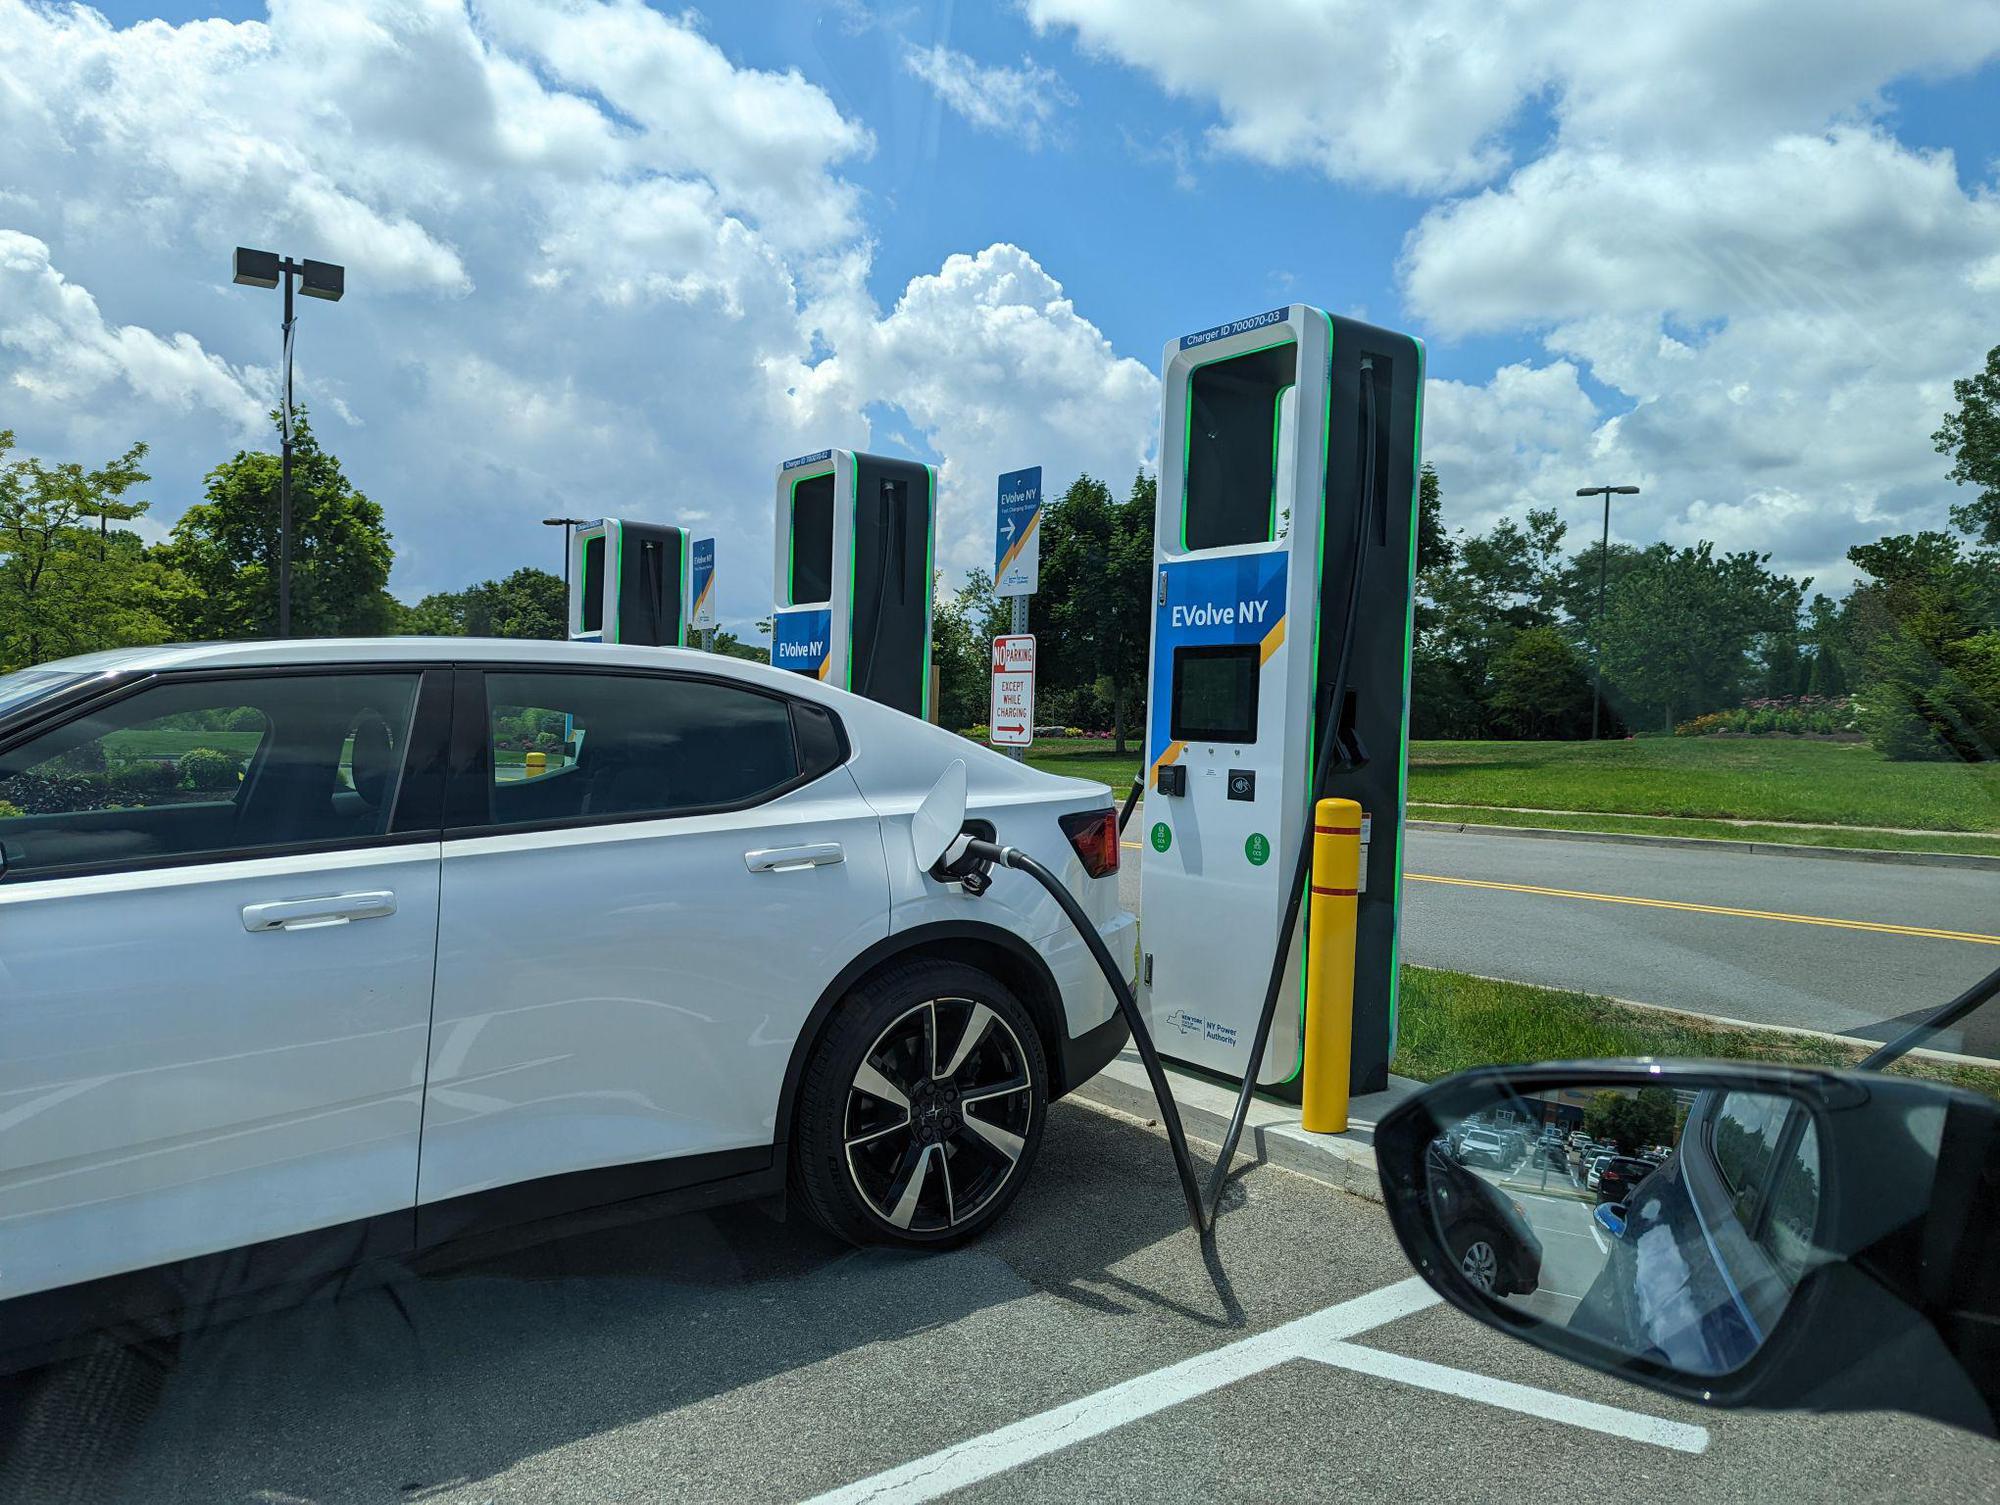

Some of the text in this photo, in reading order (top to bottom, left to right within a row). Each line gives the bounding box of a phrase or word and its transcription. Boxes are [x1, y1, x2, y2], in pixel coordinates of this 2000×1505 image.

[1187, 311, 1280, 345] Charger ID 700070-03
[1001, 487, 1037, 505] EVolve NY
[1172, 600, 1269, 627] EVolve NY
[780, 641, 823, 657] EVolve NY
[994, 646, 1032, 666] NO PARKING
[1002, 681, 1024, 692] EXCEPT
[1003, 695, 1021, 705] WHILE
[997, 707, 1027, 718] CHARGING
[1206, 1021, 1216, 1030] NY
[1217, 1024, 1237, 1036] Power
[1206, 1031, 1236, 1047] Authority
